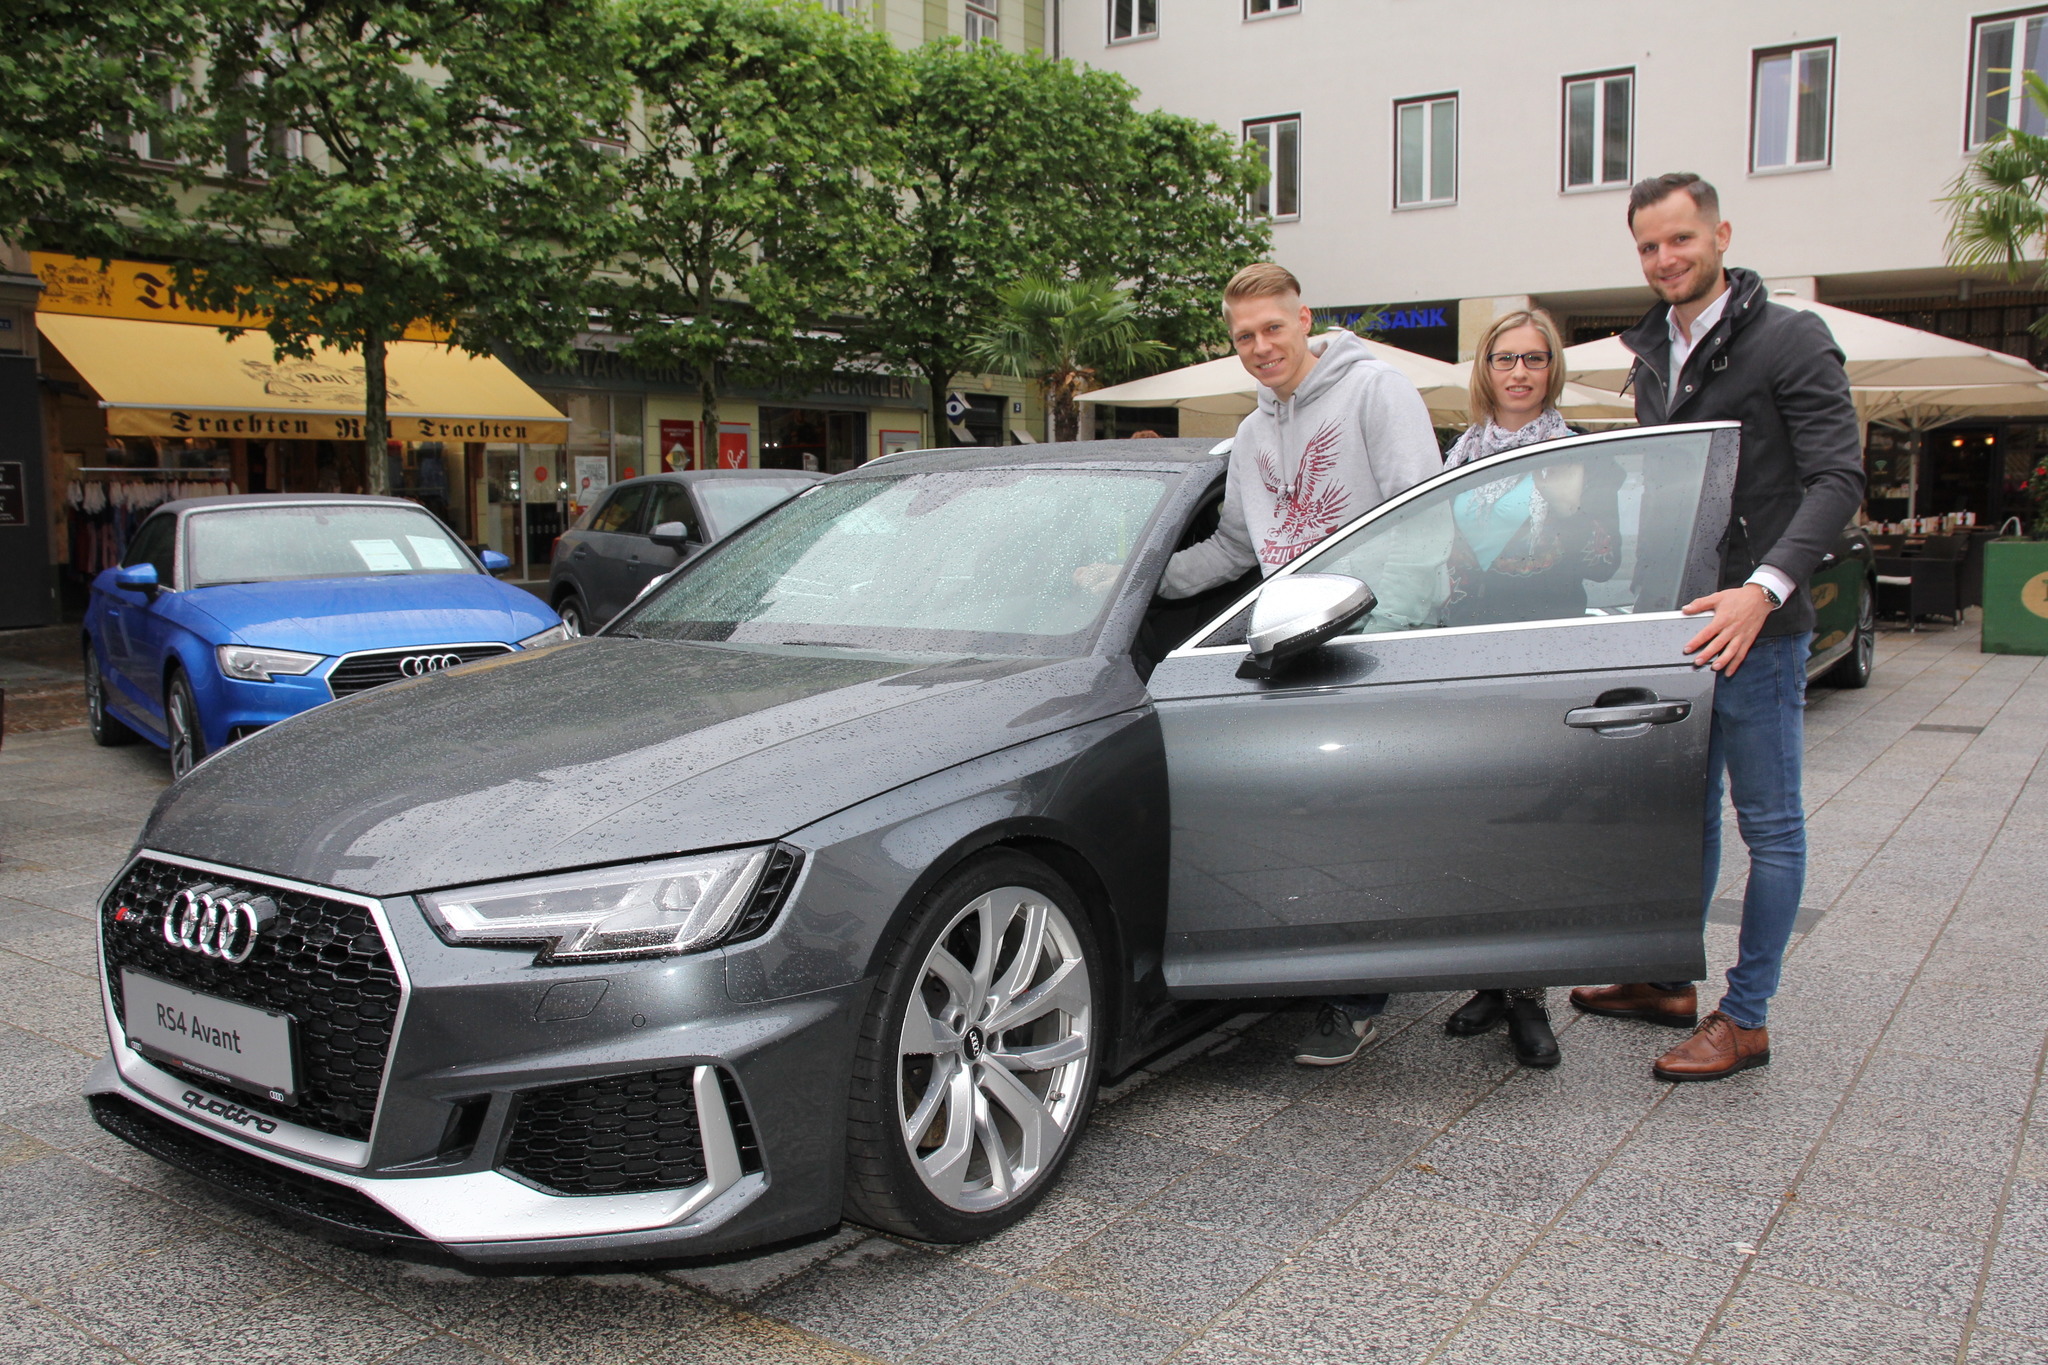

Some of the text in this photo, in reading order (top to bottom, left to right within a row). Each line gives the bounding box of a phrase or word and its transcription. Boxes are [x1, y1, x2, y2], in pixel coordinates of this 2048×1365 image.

[171, 411, 309, 434] Trachten
[418, 418, 527, 439] Trachten
[156, 1002, 242, 1054] RS4 Avant
[181, 1089, 278, 1135] quattro
